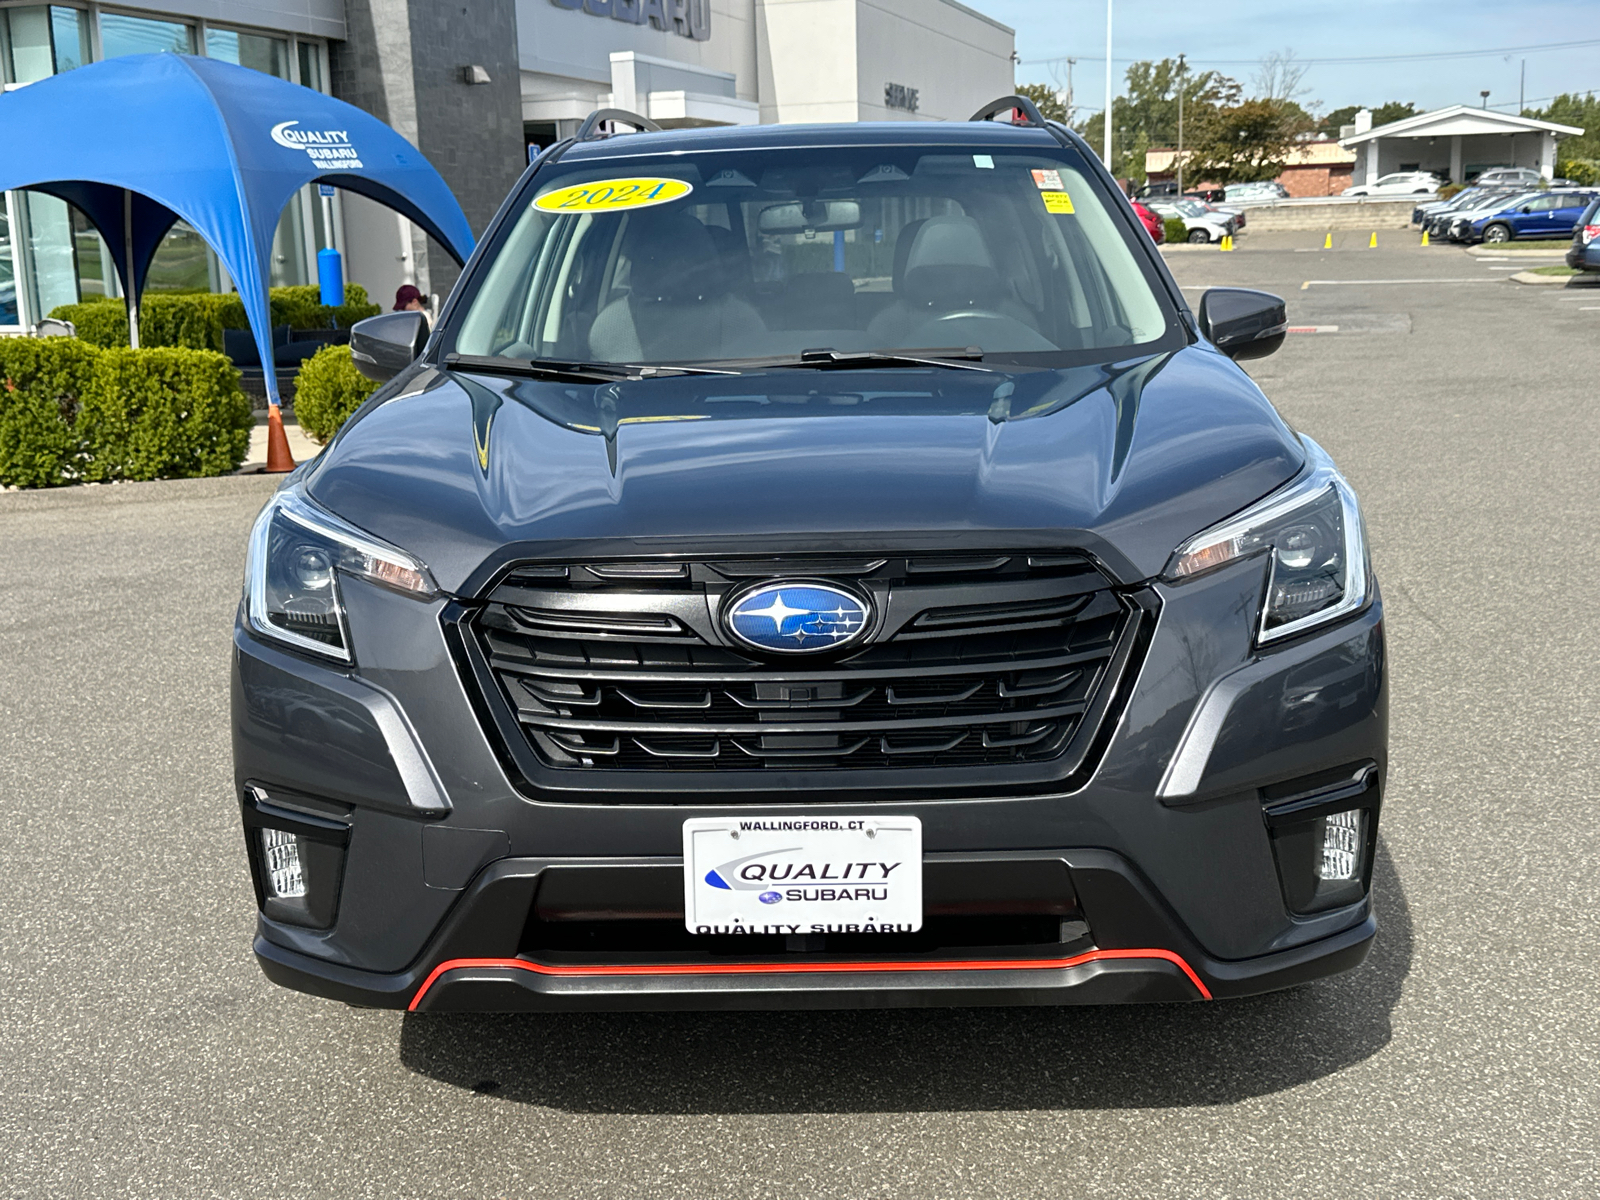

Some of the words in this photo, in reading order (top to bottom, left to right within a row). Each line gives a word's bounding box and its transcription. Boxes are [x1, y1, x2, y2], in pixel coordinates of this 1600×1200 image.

[283, 130, 348, 143] QUALITY
[306, 147, 358, 159] SUBARU
[557, 182, 667, 209] 2024
[847, 820, 866, 831] CT
[740, 862, 902, 882] QUALITY
[785, 889, 888, 902] SUBARU
[695, 924, 801, 935] QUALITY
[810, 923, 913, 934] SUBARU
